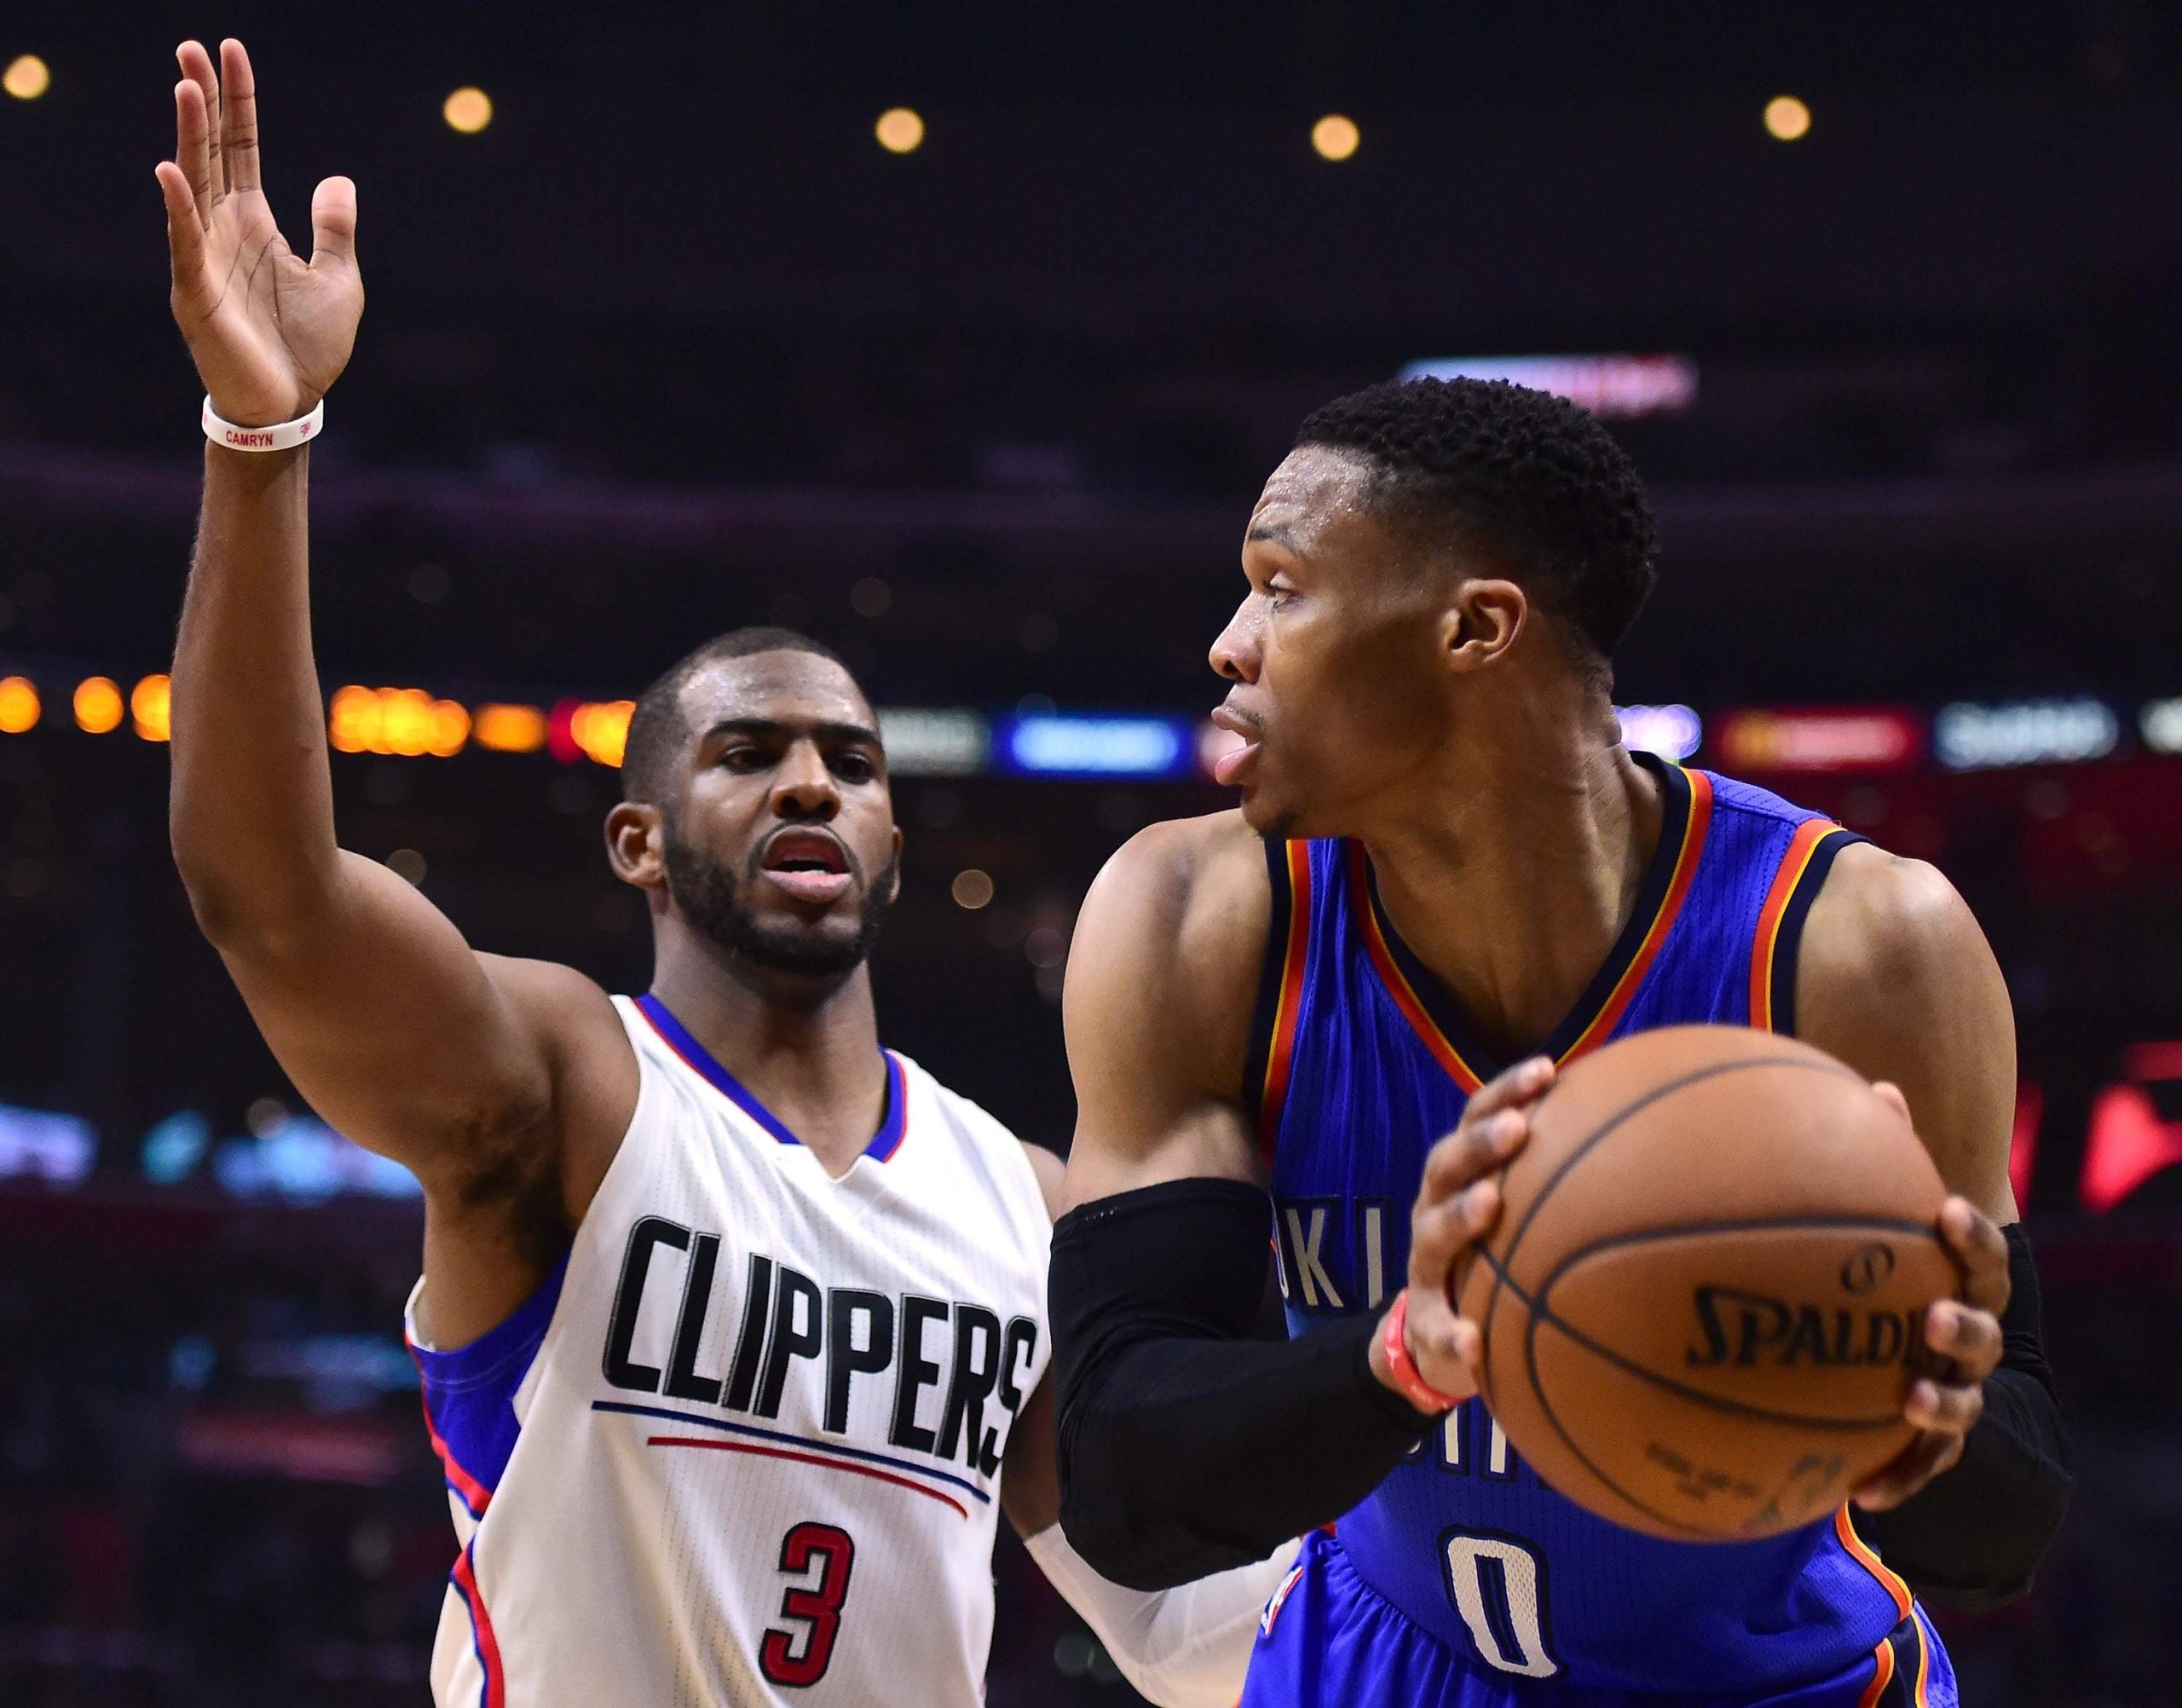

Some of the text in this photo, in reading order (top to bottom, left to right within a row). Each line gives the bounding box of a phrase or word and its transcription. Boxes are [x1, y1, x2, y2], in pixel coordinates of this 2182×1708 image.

[225, 430, 274, 447] CAMRYN
[602, 1215, 1038, 1480] CLIPPERS
[759, 1520, 855, 1688] 3
[1440, 1526, 1565, 1682] 0
